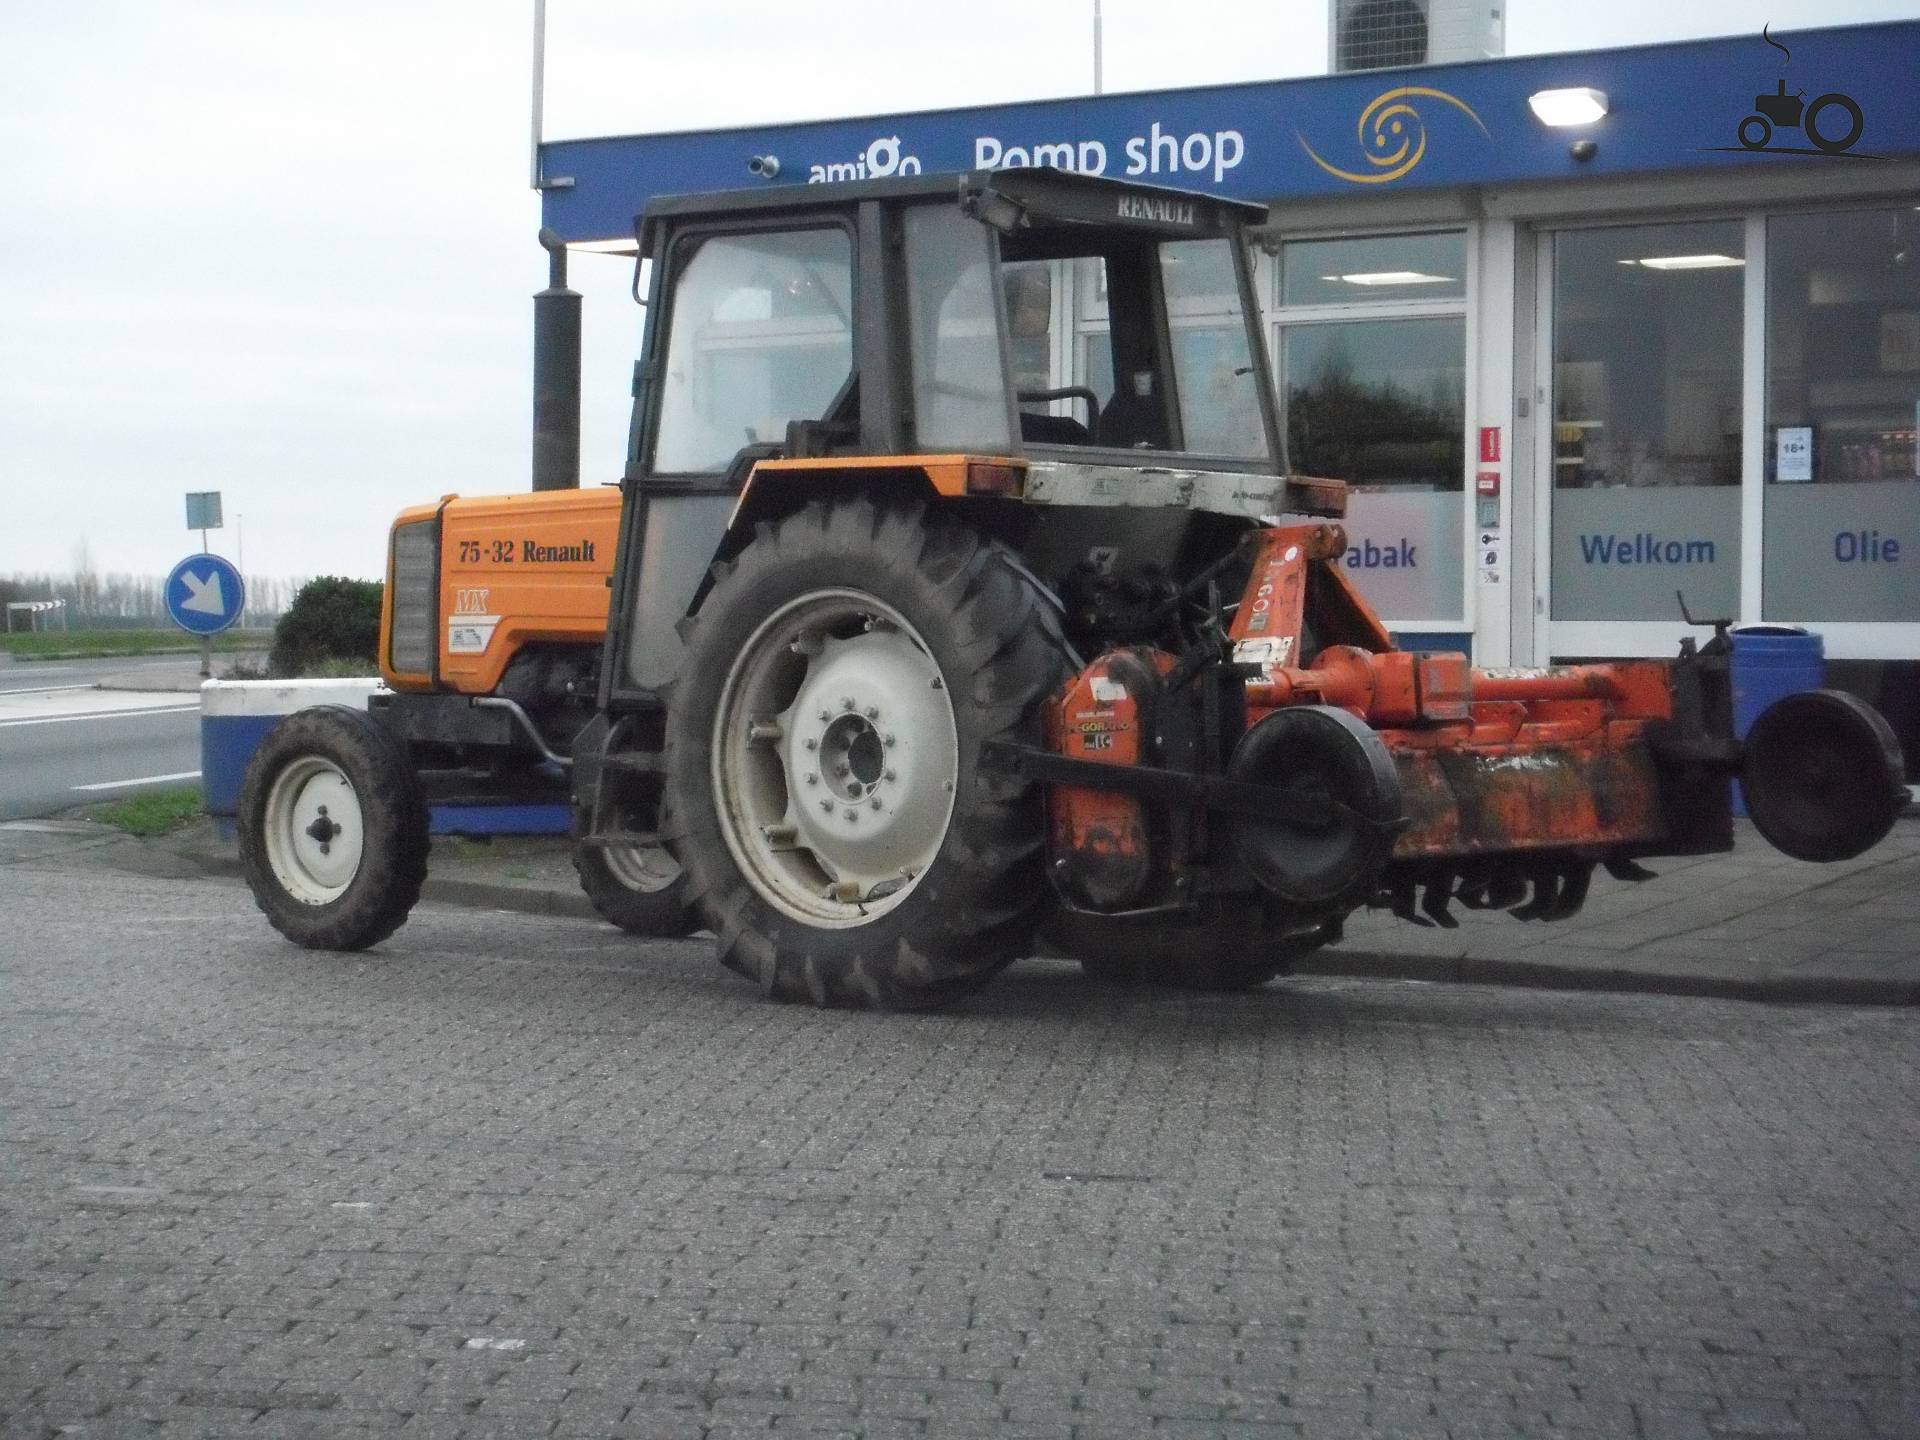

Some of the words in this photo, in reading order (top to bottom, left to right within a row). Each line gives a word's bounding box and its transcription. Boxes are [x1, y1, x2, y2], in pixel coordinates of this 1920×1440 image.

[1126, 122, 1244, 182] shop
[1117, 195, 1193, 225] RENAULT
[522, 539, 595, 562] Renault
[1346, 537, 1417, 568] abak
[1580, 532, 1715, 564] Welkom
[1834, 531, 1900, 563] Olie
